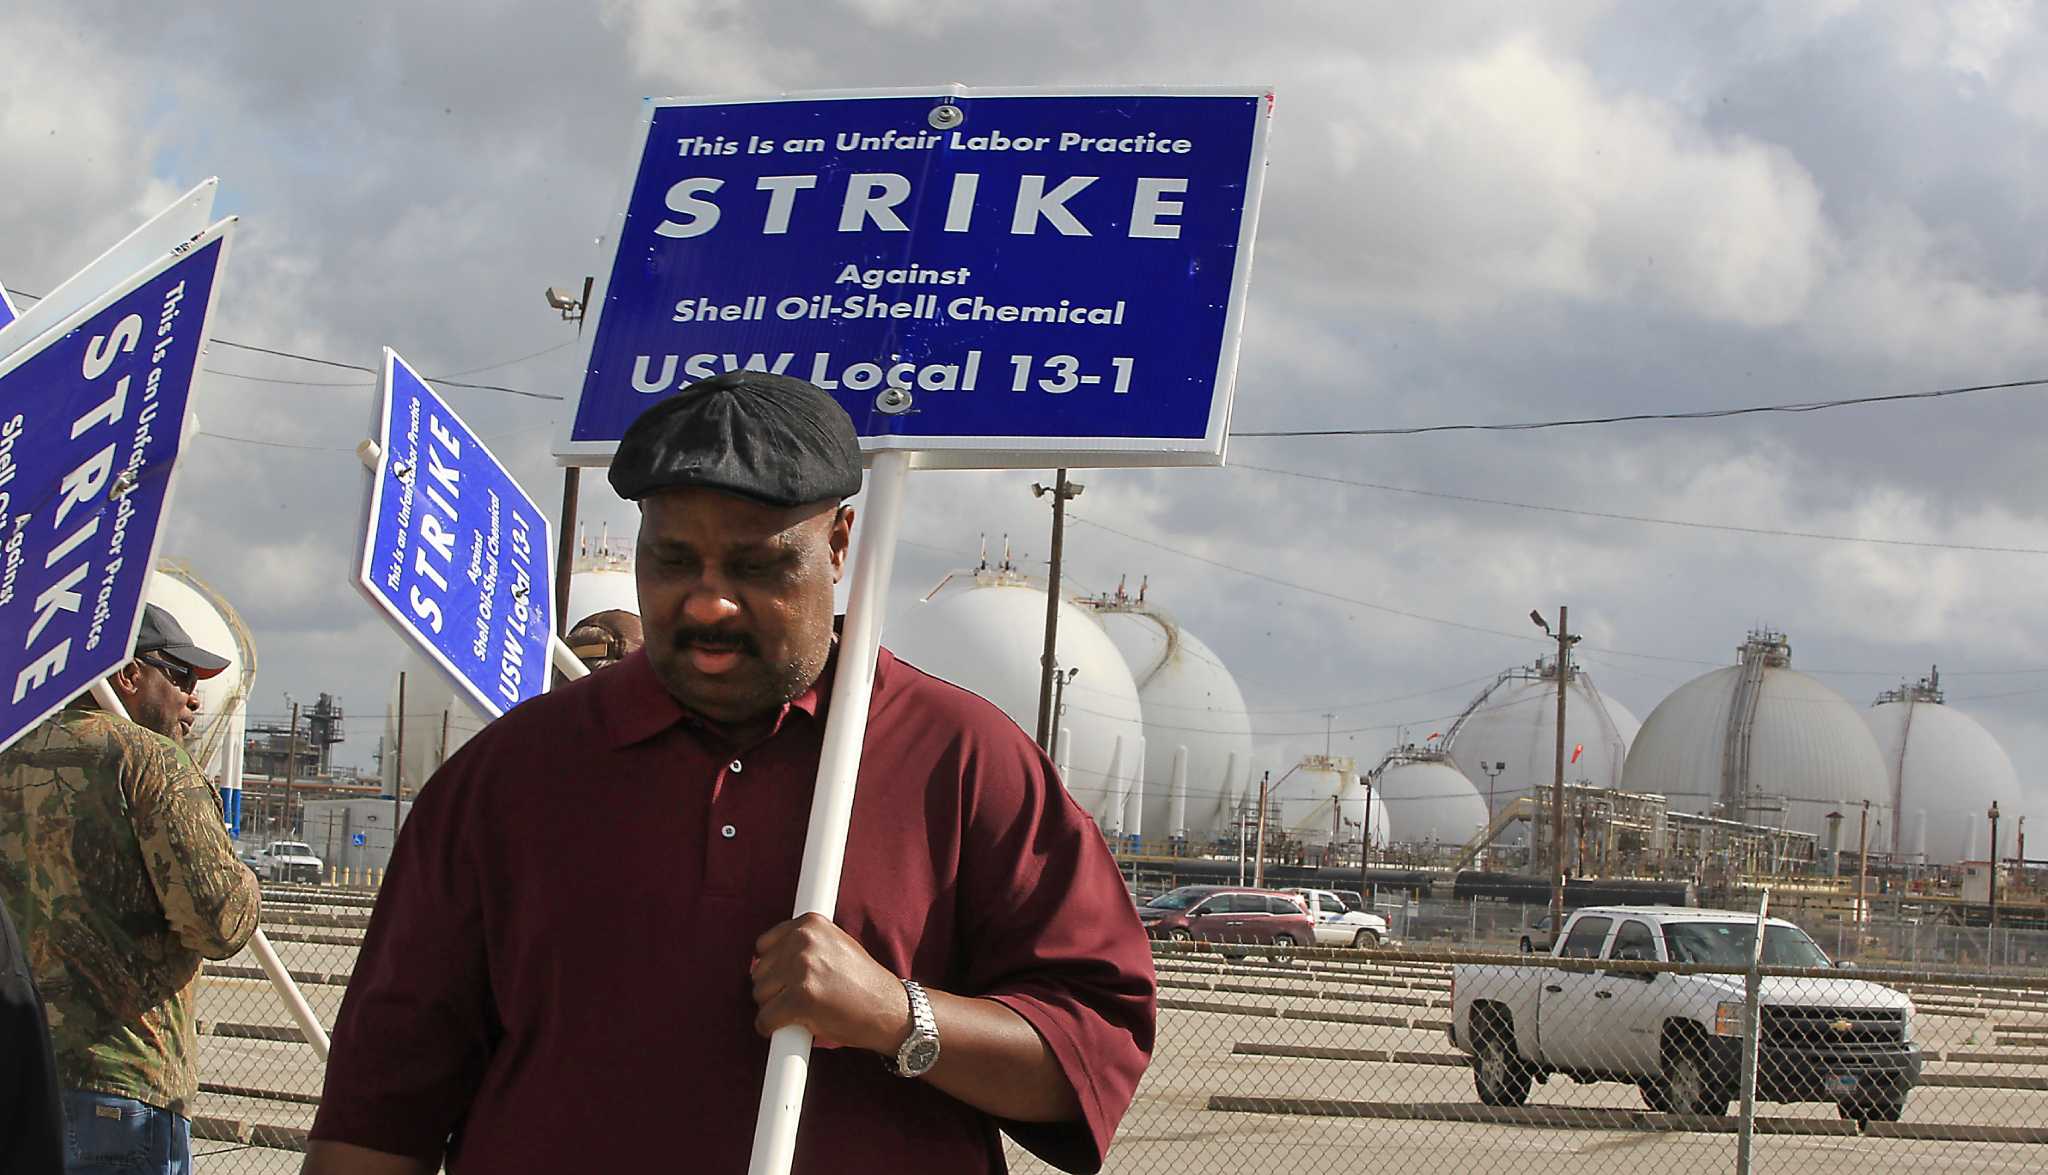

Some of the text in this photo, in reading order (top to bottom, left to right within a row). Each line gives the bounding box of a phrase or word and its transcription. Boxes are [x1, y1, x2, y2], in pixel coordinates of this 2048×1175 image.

[678, 129, 1192, 156] This Is an Unfair Labor Practice
[654, 173, 1189, 239] STRIKE
[835, 263, 971, 290] Against
[157, 280, 185, 336] This
[672, 294, 1126, 325] Shell Oil-Shell Chemical
[152, 337, 173, 364] Is
[811, 350, 982, 391] Local
[1009, 355, 1136, 393] 13-1
[144, 367, 162, 402] an
[126, 401, 159, 480] Unfair
[407, 397, 421, 446] Practice
[12, 313, 142, 705] STRIKE
[410, 414, 462, 634] STRIKE
[393, 547, 404, 563] Is
[397, 528, 407, 549] an
[467, 529, 484, 585] Against
[387, 561, 402, 591] This
[474, 489, 500, 662] Shell Oil-Shell Chemical
[85, 557, 123, 651] Practice
[499, 628, 525, 703] USW
